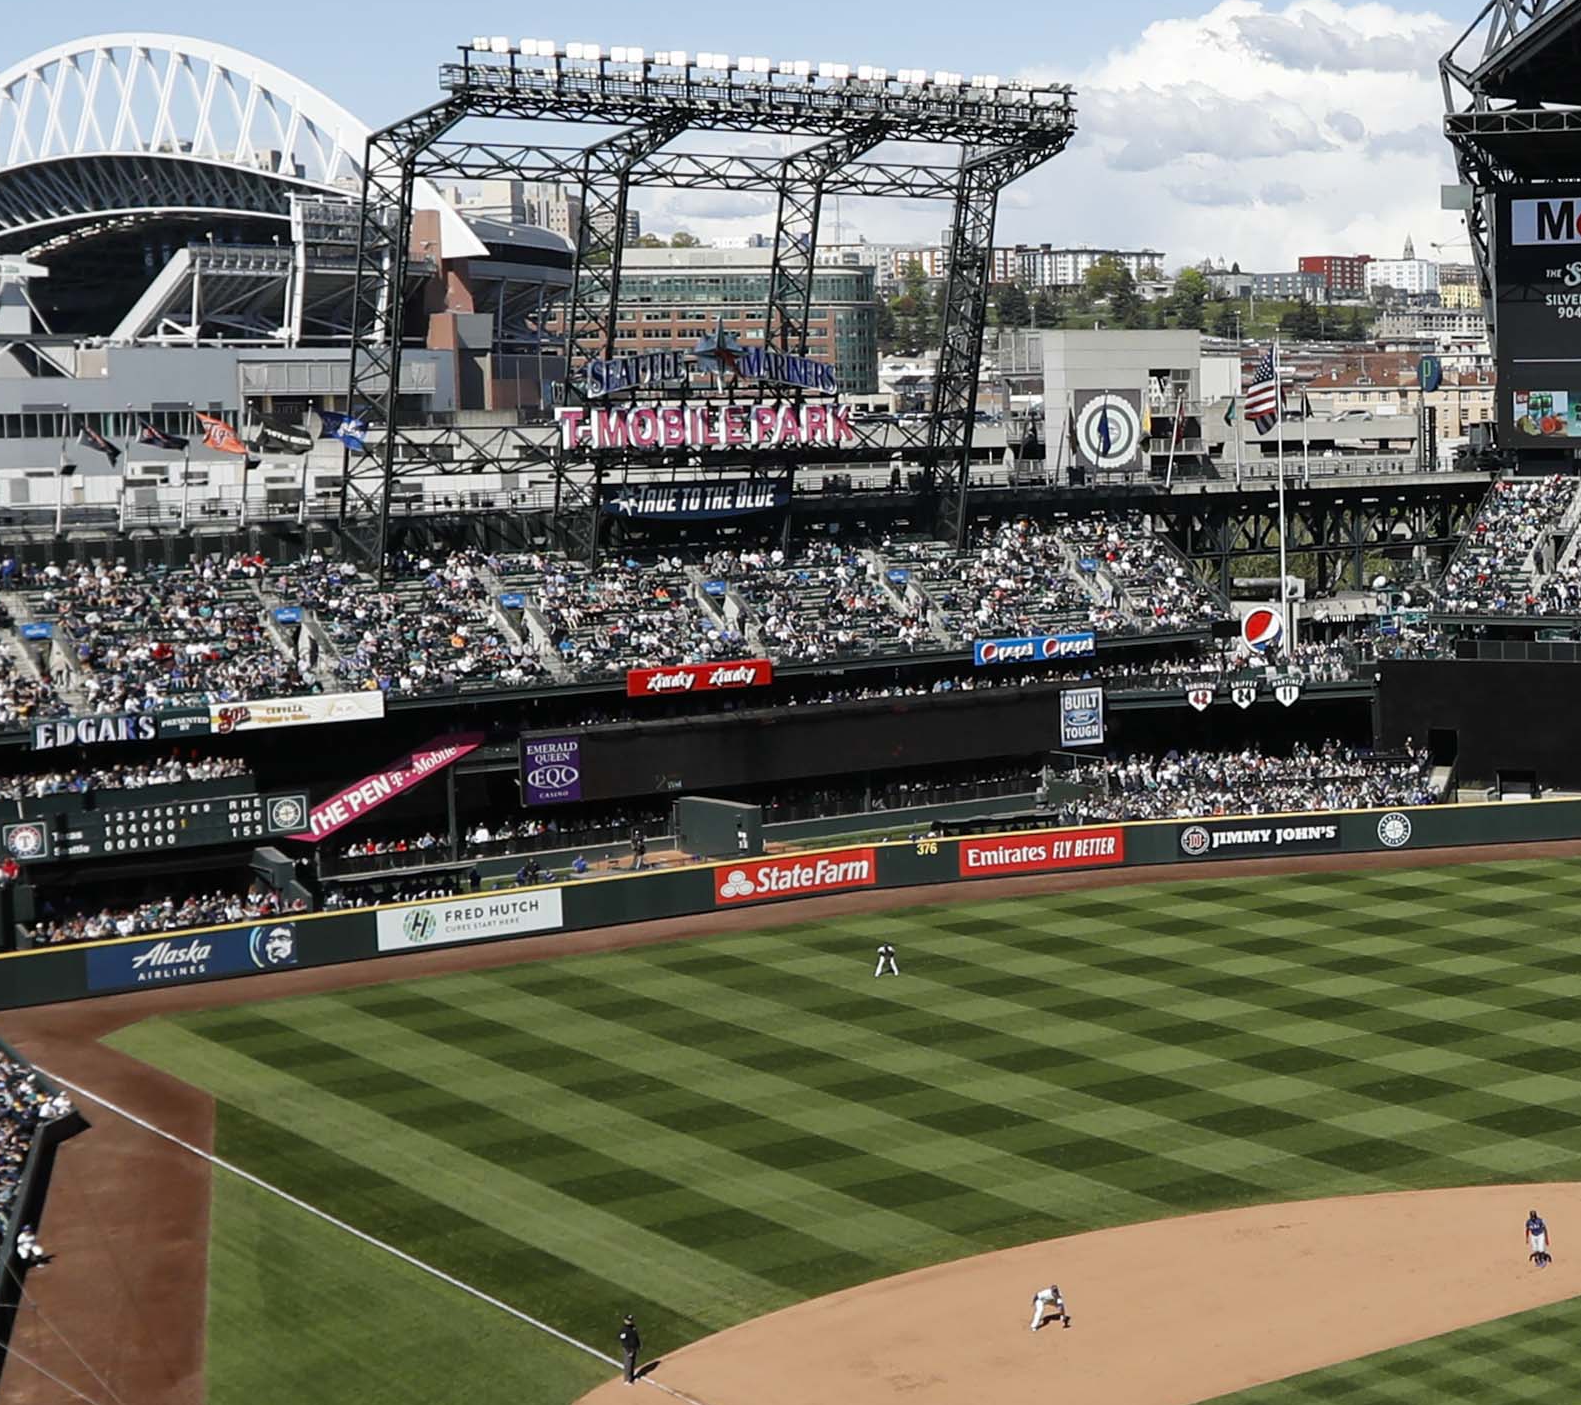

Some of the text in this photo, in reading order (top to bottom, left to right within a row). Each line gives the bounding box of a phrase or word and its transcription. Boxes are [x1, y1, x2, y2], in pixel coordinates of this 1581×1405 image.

[1546, 269, 1562, 278] THE
[587, 346, 838, 398] SEATTLE MARINERS
[554, 402, 854, 450] T-MOBILE PARK
[637, 481, 775, 512] TRUE TO THE BLUE
[1064, 694, 1099, 711] BUILT
[1193, 691, 1208, 705] 42
[161, 716, 209, 728] PRESENTED
[1064, 725, 1099, 740] TOUGH
[526, 741, 578, 756] EMERALD
[534, 752, 570, 763] QUEEN
[540, 790, 569, 799] CASINO
[1212, 825, 1334, 848] JIMMY JOHN'S
[916, 842, 938, 856] 376
[967, 837, 1116, 868] Emirates FLY BETTER
[444, 901, 539, 923] FRED HUTCH
[445, 917, 520, 933] CURES START HERE
[132, 938, 211, 970] Alaska
[137, 963, 205, 982] AIRLINES
